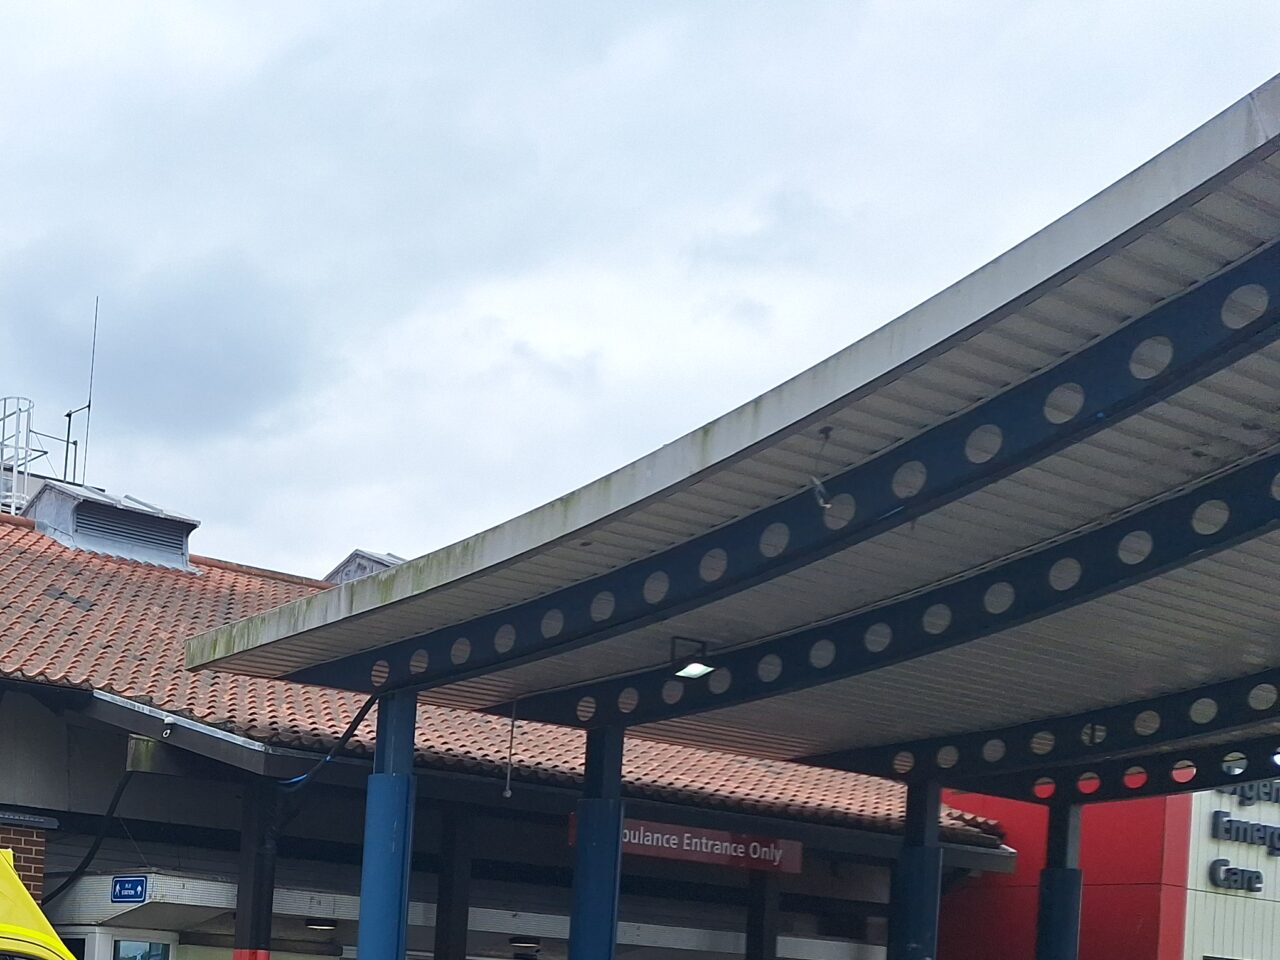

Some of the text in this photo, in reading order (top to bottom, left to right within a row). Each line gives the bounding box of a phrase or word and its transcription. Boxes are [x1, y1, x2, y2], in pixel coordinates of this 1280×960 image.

[622, 826, 783, 866] bulance Entrance Only
[1209, 858, 1263, 892] Care
